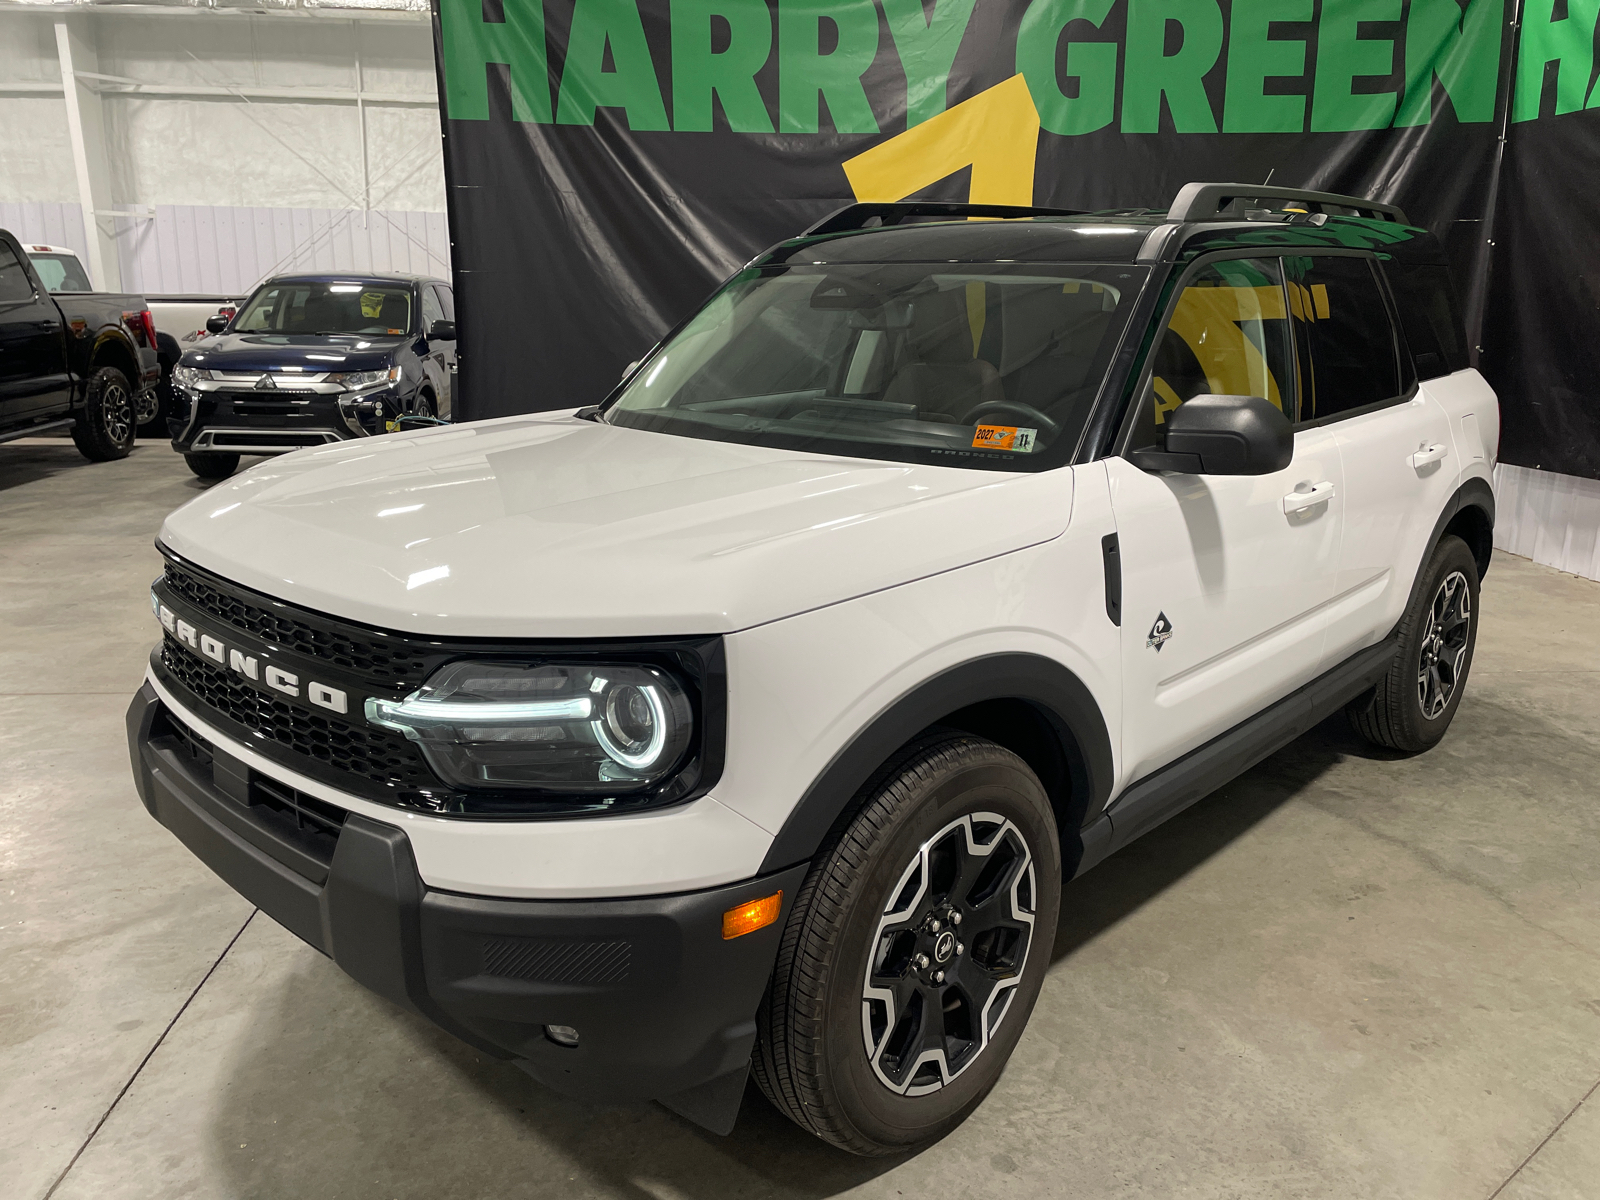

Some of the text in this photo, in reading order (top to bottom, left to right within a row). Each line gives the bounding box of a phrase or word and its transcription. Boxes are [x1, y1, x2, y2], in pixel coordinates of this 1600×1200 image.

[439, 0, 1504, 136] HARRY GREEN
[976, 428, 994, 440] 2027
[1019, 433, 1029, 447] 11
[160, 605, 348, 714] BRONCO
